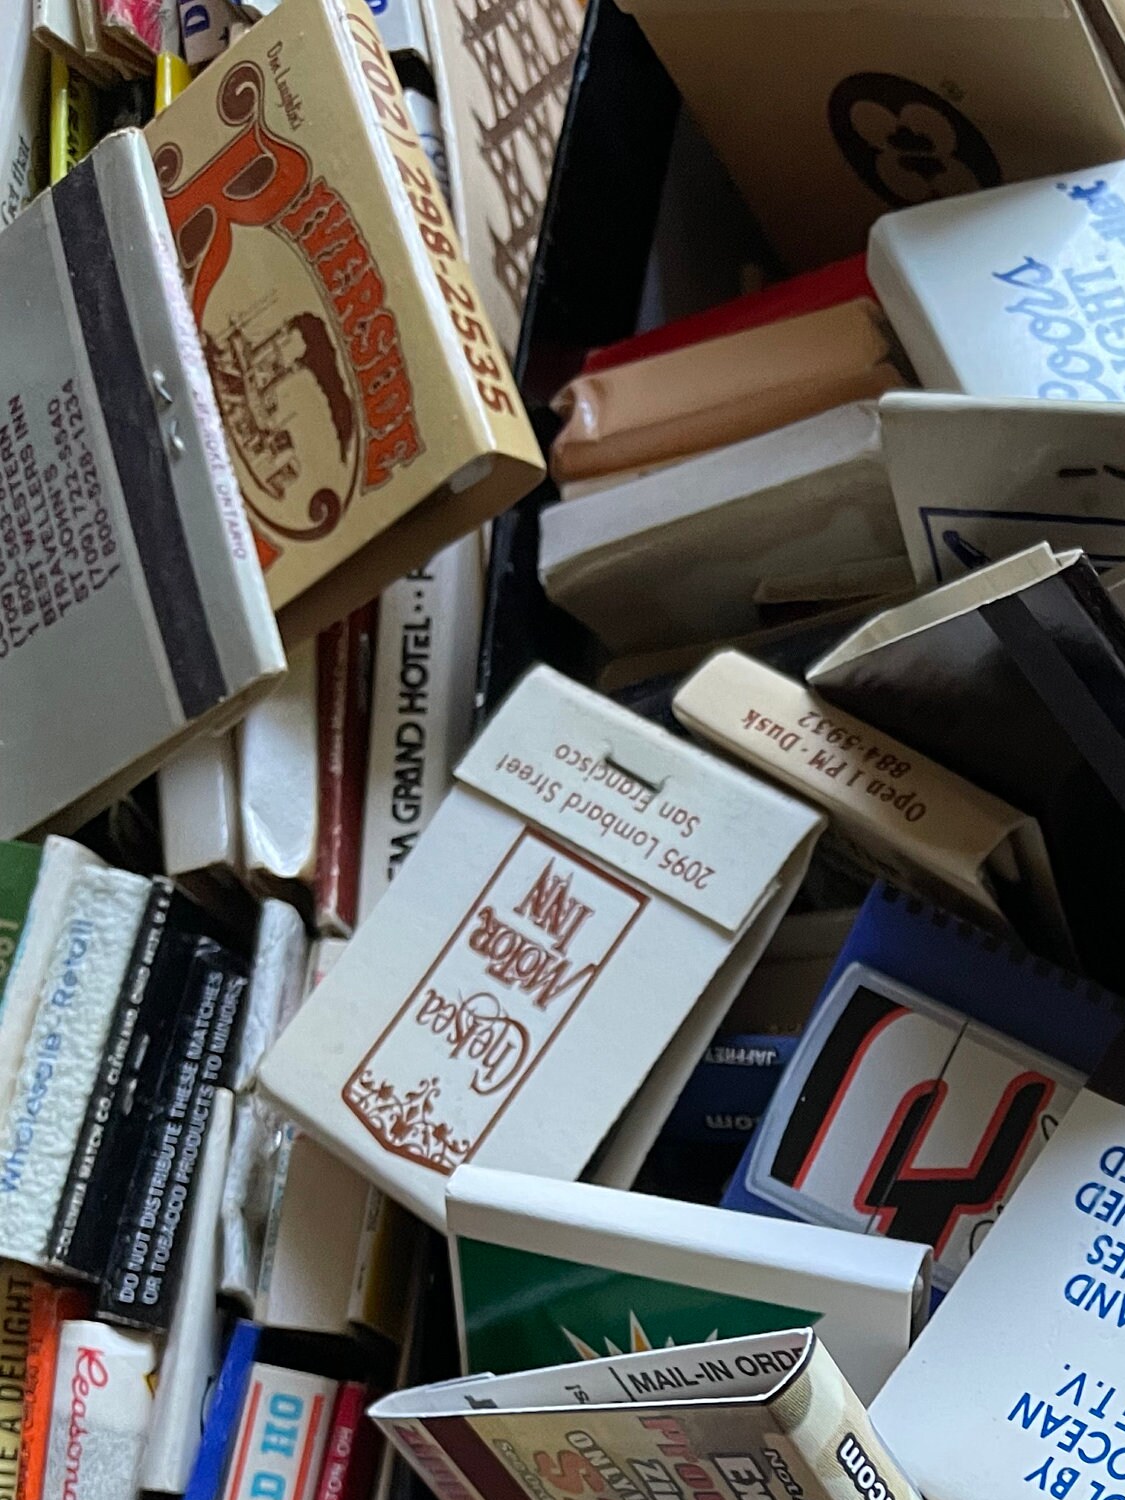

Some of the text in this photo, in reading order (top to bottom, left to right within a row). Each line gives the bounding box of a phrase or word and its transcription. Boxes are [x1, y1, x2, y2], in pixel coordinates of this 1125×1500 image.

[338, 11, 525, 430] (702) 298-2535
[6, 392, 73, 617] TRAVELLERS INN
[69, 569, 91, 603] ST
[396, 614, 437, 714] HOTEL
[387, 719, 431, 823] GRAND
[489, 746, 717, 894] 2095 Lombard Street
[545, 731, 704, 842] San Francisco
[736, 706, 932, 826] Open PM Dusk
[449, 896, 599, 1025] MOTOR
[503, 851, 609, 959] INN
[393, 963, 547, 1108] Chelsea
[114, 967, 227, 1304] DO NOT DISTRIBUTE THESE MATCHES
[138, 1051, 225, 1307] OR TOBACCO PRODUCTS TO
[0, 1276, 33, 1403] DELIGHT
[624, 1354, 738, 1399] MAIL-IN
[1048, 1359, 1121, 1421] T.V.
[258, 1387, 310, 1459] HO
[331, 1423, 356, 1459] OH
[752, 1447, 810, 1497] Not
